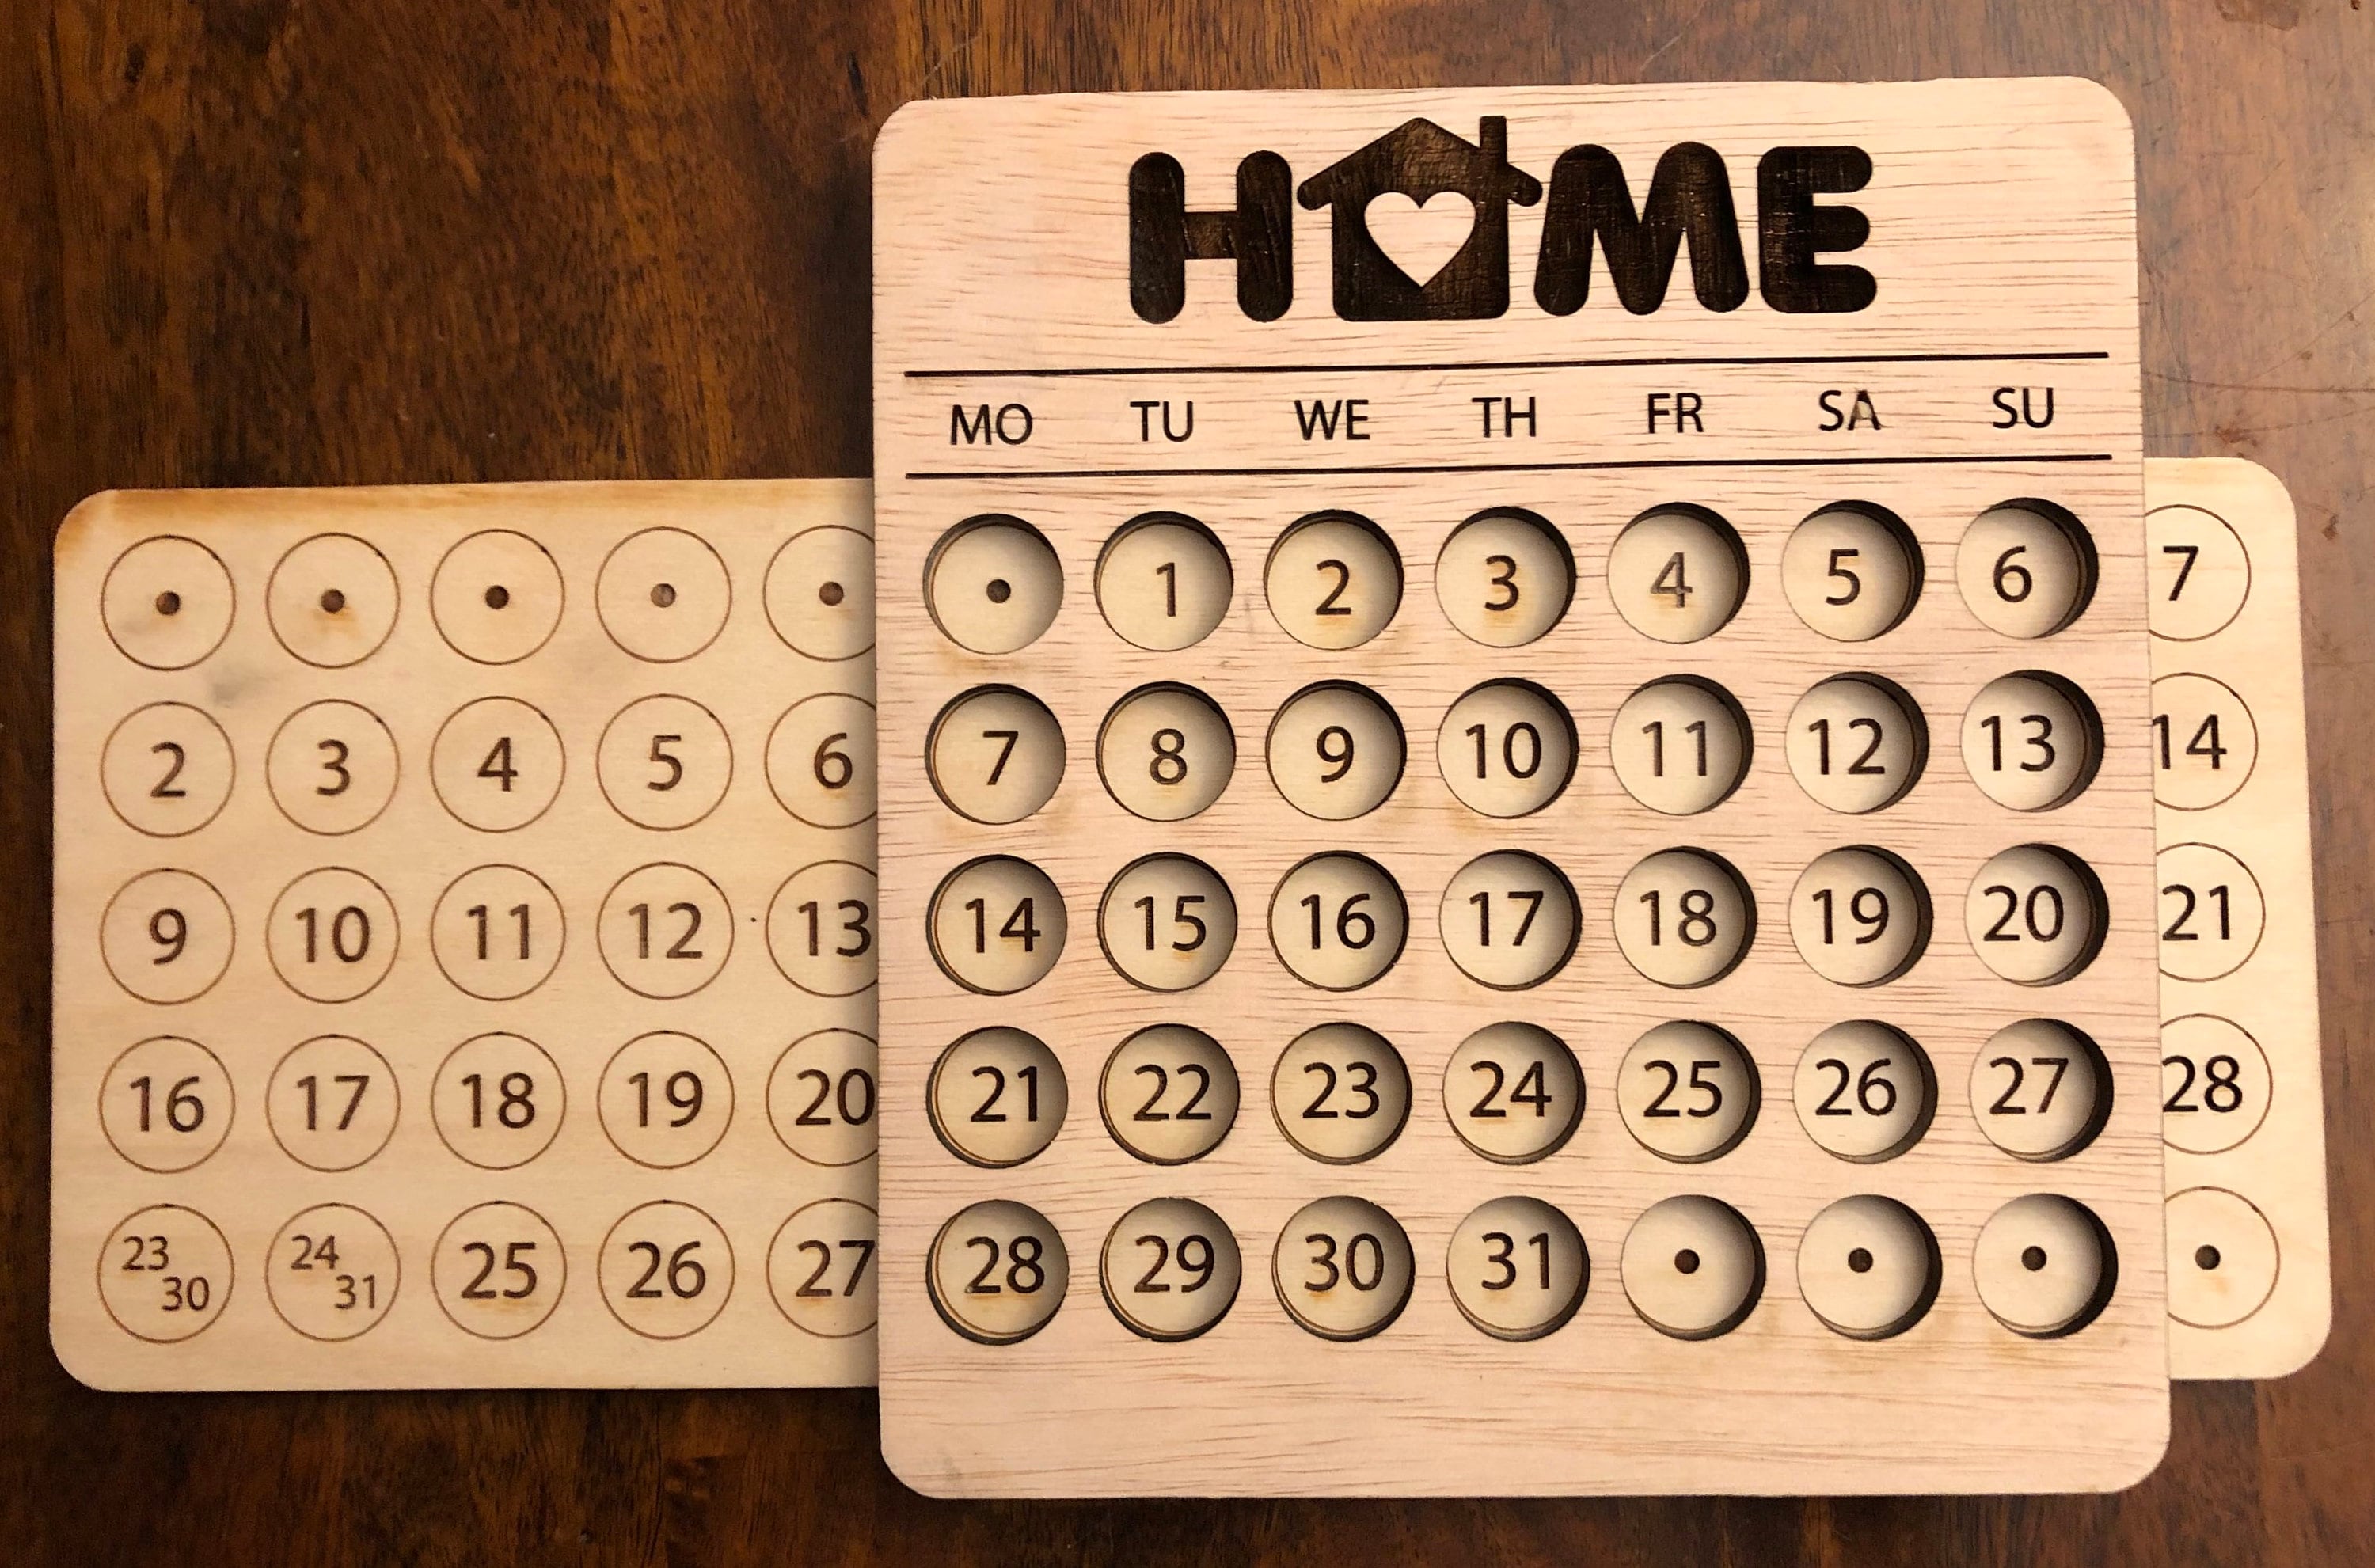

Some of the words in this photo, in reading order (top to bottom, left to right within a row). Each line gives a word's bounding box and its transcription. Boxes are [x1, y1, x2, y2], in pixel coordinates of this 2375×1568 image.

[951, 404, 1033, 445] MO
[1130, 401, 1193, 442] TU
[1294, 399, 1370, 440] WE
[1472, 397, 1536, 438] TH
[1647, 393, 1704, 434] FR
[1819, 389, 1883, 431] SA
[1992, 387, 2054, 429] SU
[1157, 562, 1176, 617] 1
[1316, 560, 1351, 615] 2
[1484, 555, 1519, 611] 3
[1651, 552, 1693, 608] 4
[1826, 549, 1860, 606] 5
[1993, 546, 2032, 602] 6
[2163, 546, 2198, 601] 7
[151, 742, 186, 798] 2
[317, 739, 351, 796] 3
[477, 737, 518, 792] 4
[648, 735, 682, 792] 5
[814, 732, 853, 789] 6
[983, 731, 1018, 785] 7
[1150, 728, 1188, 785] 8
[1317, 726, 1354, 783] 9
[1466, 723, 1541, 779] 10
[1643, 721, 1707, 777] 11
[1809, 718, 1885, 775] 12
[1981, 715, 2055, 772] 13
[2153, 714, 2227, 769] 14
[150, 908, 187, 965] 9
[296, 905, 370, 963] 10
[467, 904, 530, 960] 11
[629, 902, 703, 959] 12
[798, 900, 872, 957] 13
[965, 898, 1040, 953] 14
[1135, 896, 1206, 951] 15
[1301, 894, 1375, 949] 16
[1469, 891, 1543, 947] 17
[1640, 890, 1716, 947] 18
[1813, 888, 1889, 944] 19
[1984, 885, 2063, 942] 20
[2162, 884, 2229, 940] 21
[131, 1076, 205, 1133] 16
[297, 1075, 369, 1131] 17
[462, 1072, 535, 1129] 18
[629, 1071, 703, 1127] 19
[796, 1069, 876, 1126] 20
[971, 1066, 1037, 1122] 21
[1133, 1064, 1211, 1122] 22
[1302, 1062, 1379, 1118] 23
[1470, 1061, 1552, 1118] 24
[1644, 1060, 1722, 1117] 25
[1815, 1059, 1895, 1115] 26
[1989, 1057, 2068, 1115] 27
[2162, 1055, 2243, 1113] 28
[123, 1236, 169, 1271] 23
[291, 1235, 340, 1270] 24
[462, 1242, 537, 1299] 25
[626, 1241, 706, 1299] 26
[796, 1240, 876, 1297] 27
[967, 1236, 1044, 1294] 28
[1134, 1235, 1214, 1293] 29
[1305, 1233, 1384, 1293] 30
[1482, 1232, 1549, 1290] 31
[162, 1277, 210, 1312] 30
[335, 1274, 375, 1310] 31
